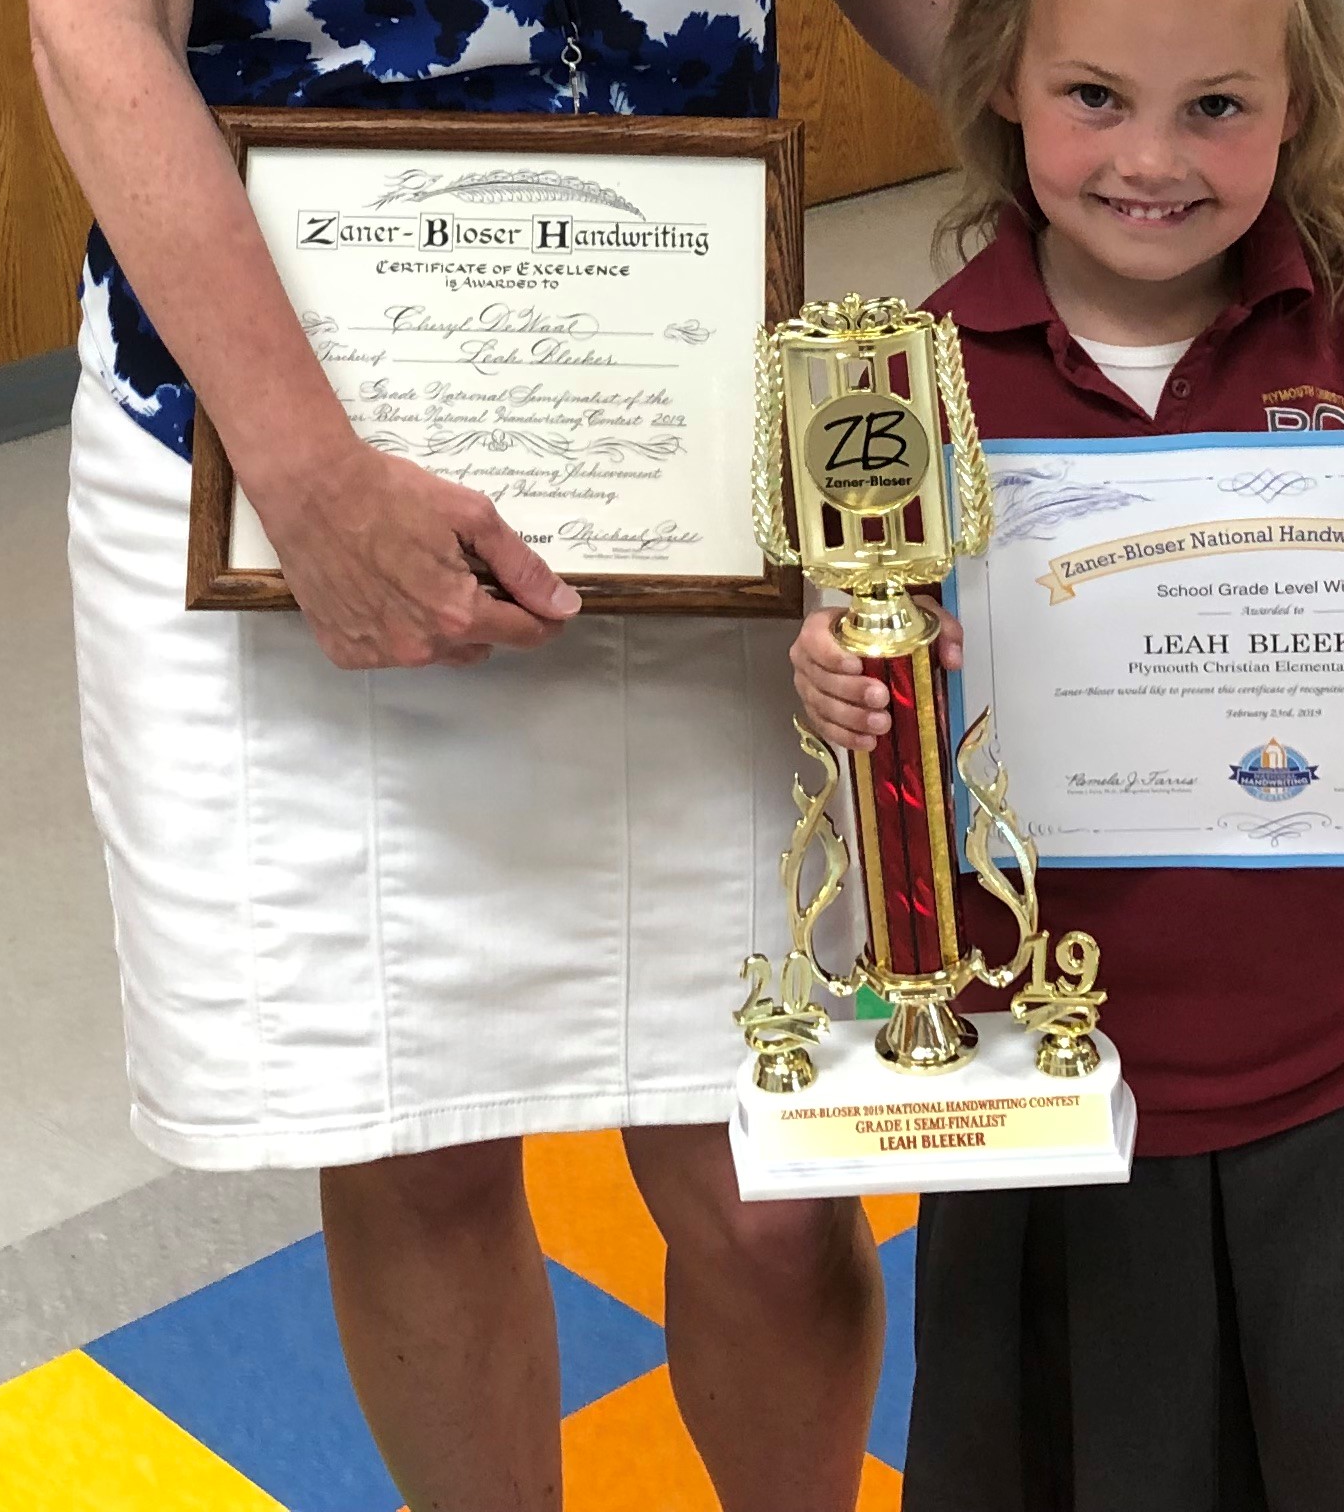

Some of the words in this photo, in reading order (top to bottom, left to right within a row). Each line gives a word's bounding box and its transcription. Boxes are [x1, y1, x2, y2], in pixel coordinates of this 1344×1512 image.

[422, 218, 523, 248] Bloser
[536, 220, 710, 256] Handwriting
[460, 339, 523, 375] Leah
[359, 377, 418, 402] Grade
[424, 381, 508, 406] National
[622, 389, 645, 410] of
[646, 388, 673, 406] the
[1262, 384, 1315, 404] PLYMOUTH
[424, 405, 489, 429] National
[494, 406, 584, 431] Handwriting
[583, 409, 643, 426] Contest
[651, 413, 684, 426] 2019
[824, 410, 909, 471] ZB
[455, 463, 473, 482] of
[473, 463, 562, 483] outstanding
[560, 462, 662, 486] Achievement
[825, 475, 912, 488] Zaner-Bloser
[491, 483, 511, 503] of
[518, 530, 554, 544] loser
[1060, 538, 1186, 578] Zaner-Bloser
[1190, 525, 1274, 550] National
[1157, 583, 1213, 598] School
[1218, 582, 1269, 597] Grade
[1274, 580, 1318, 595] Level
[1241, 605, 1290, 616] Awarded
[1293, 605, 1305, 615] to
[1143, 634, 1229, 655] LEAH
[1128, 661, 1199, 676] Plymouth
[1203, 661, 1270, 673] Christian
[1117, 685, 1147, 695] would
[1149, 685, 1167, 696] like
[1169, 686, 1179, 695] to
[1180, 686, 1215, 697] present
[1217, 685, 1235, 695] this
[1237, 684, 1286, 696] certificate
[1287, 684, 1298, 696] of
[1226, 708, 1268, 720] February
[1297, 708, 1323, 718] 2019
[1241, 777, 1309, 786] HANDWRITING
[1018, 929, 1101, 996] 19
[733, 949, 813, 1025] 20
[781, 1105, 861, 1120] ZANER-BLOSER
[862, 1104, 885, 1117] 2019
[886, 1101, 945, 1115] NATIONAL
[946, 1097, 1027, 1113] HANDWRITING
[1028, 1095, 1081, 1109] CONTEST
[855, 1119, 903, 1134] GRADE
[913, 1114, 1008, 1131] SEMI-FINALIST
[879, 1135, 917, 1151] LEAH
[921, 1132, 987, 1149] BLEEKER
